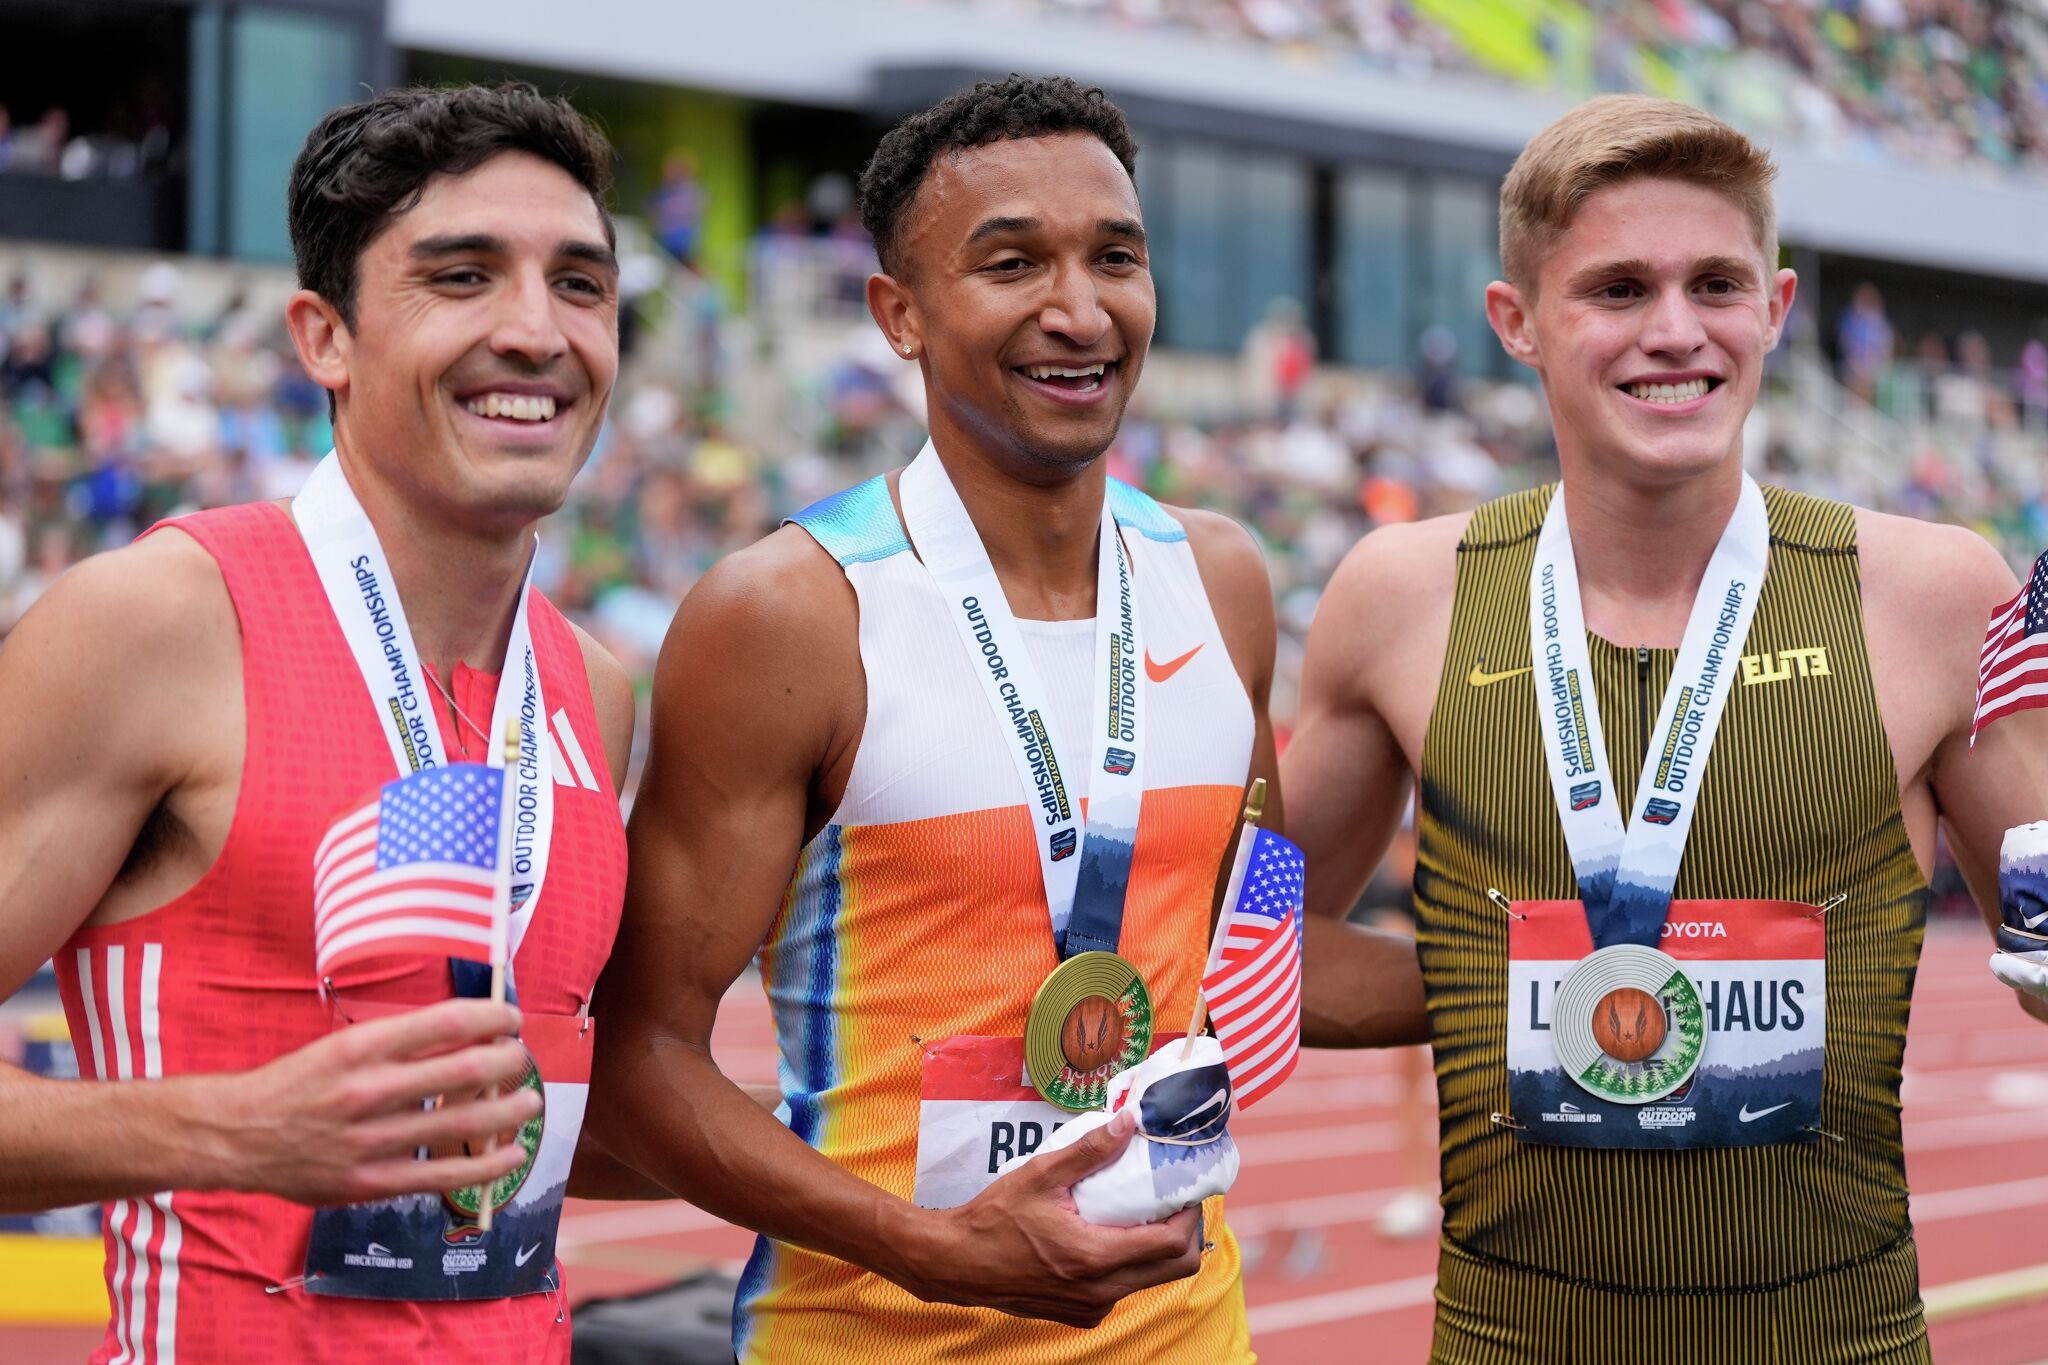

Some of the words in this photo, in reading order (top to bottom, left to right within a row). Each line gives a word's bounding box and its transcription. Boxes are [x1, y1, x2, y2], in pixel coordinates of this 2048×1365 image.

[1542, 563, 1559, 641] OUTDOOR
[350, 554, 418, 711] CHAMPIONSHIPS
[1111, 634, 1120, 667] USATF
[1110, 668, 1119, 708] TOYOTA
[1120, 658, 1136, 742] OUTDOOR
[1568, 670, 1580, 697] 2025
[1668, 709, 1706, 793] OUTDOOR
[1694, 579, 1746, 707] CHAMPIONSHIPS
[520, 645, 538, 781] CHAMPIONSHIPS
[962, 596, 1009, 682] OUTDOOR
[1000, 683, 1061, 826] CHAMPIONSHIPS
[1110, 709, 1119, 737] 2025
[1546, 643, 1582, 777] CHAMPIONSHIPS
[1573, 698, 1588, 738] TOYOTA
[1580, 738, 1593, 771] USATF
[1656, 761, 1670, 788] 2025
[1663, 719, 1683, 759] TOYOTA
[1675, 688, 1692, 719] USATF
[1030, 712, 1046, 740] 2025
[1042, 741, 1061, 784] TOYOTA
[1055, 783, 1070, 818] USATF
[515, 784, 538, 874] OUTDOOR
[1661, 921, 1728, 938] OYOTA
[1541, 1113, 1586, 1123] TRACKTOWN
[1587, 1114, 1602, 1123] USA
[1637, 1111, 1697, 1121] OUTDOOR
[344, 1254, 396, 1269] TRACKTOWN
[396, 1257, 414, 1269] USA
[442, 1254, 488, 1265] OUTDOOR
